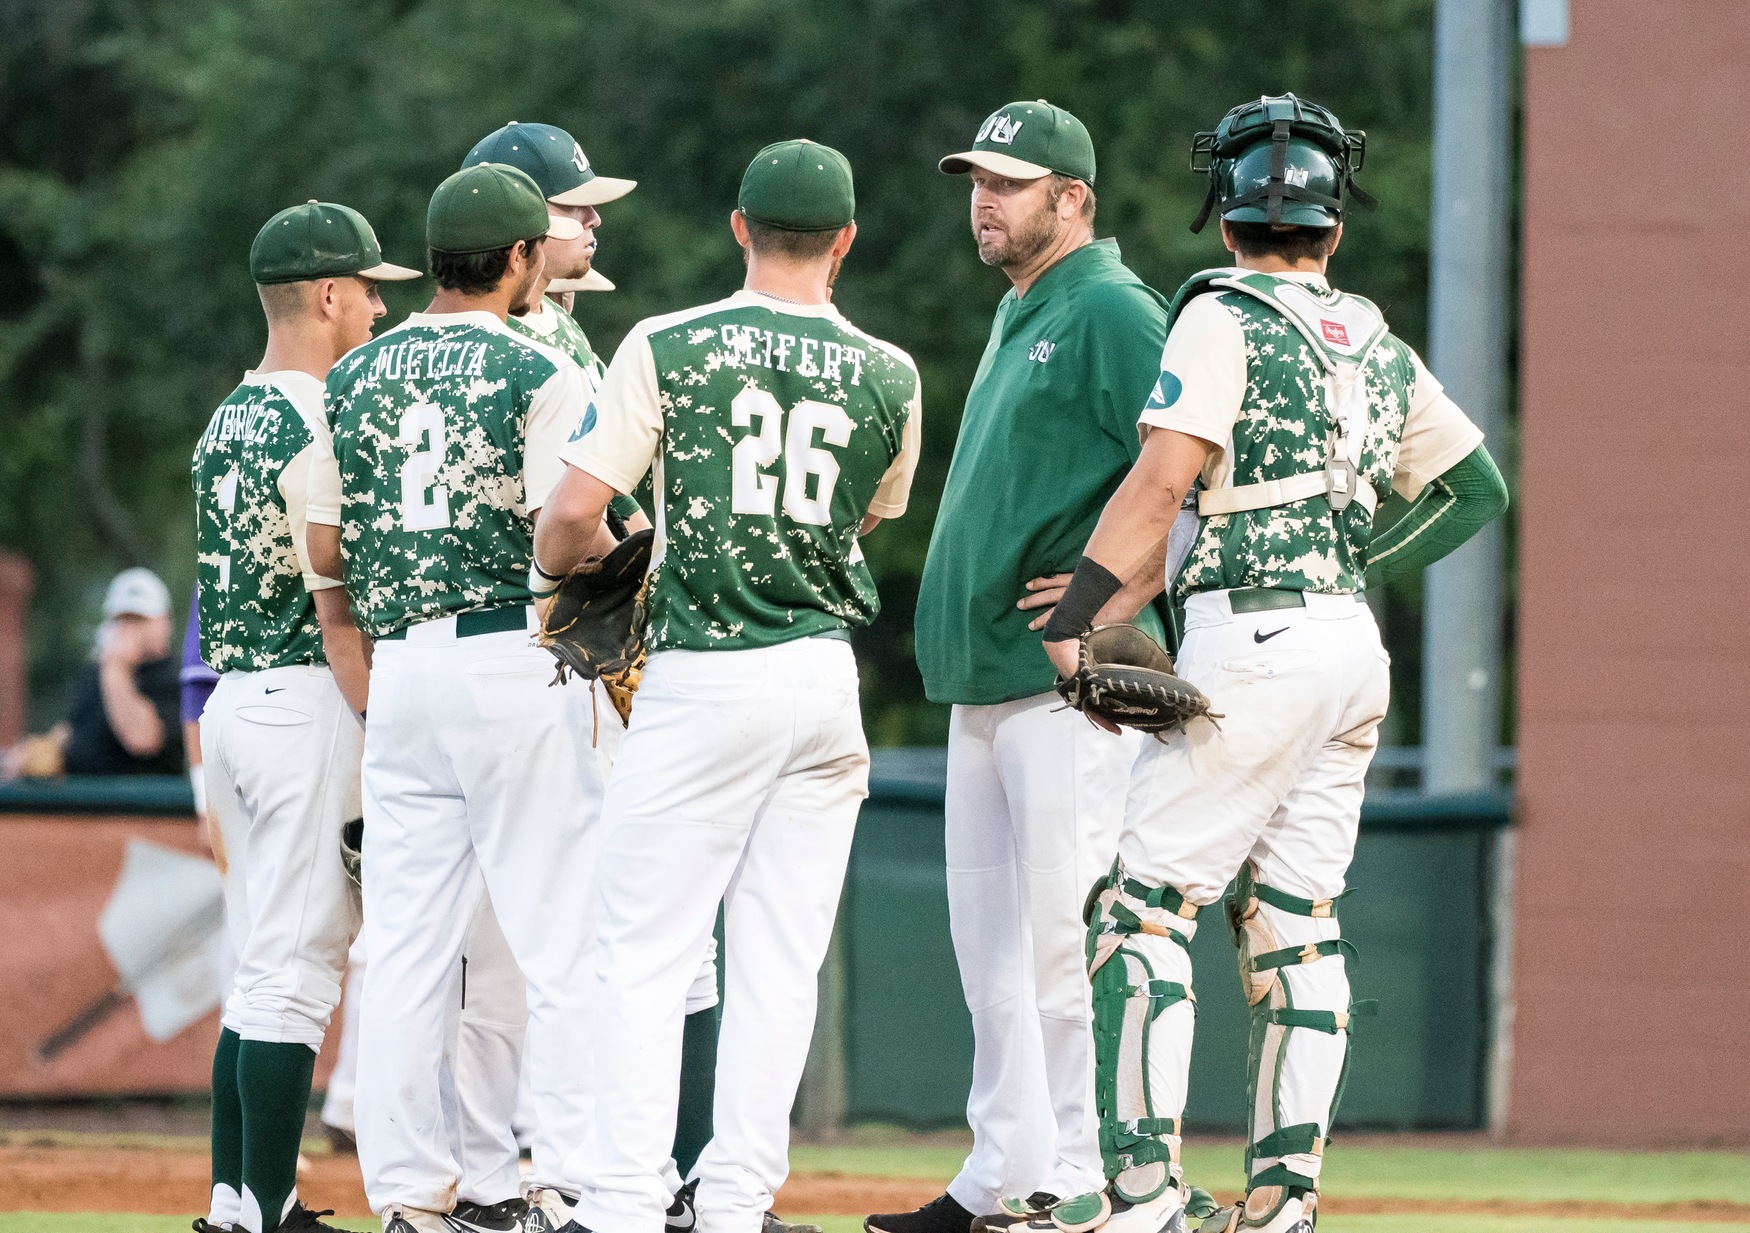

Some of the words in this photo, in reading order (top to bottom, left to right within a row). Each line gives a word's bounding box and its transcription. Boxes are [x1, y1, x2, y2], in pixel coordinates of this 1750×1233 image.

[720, 324, 866, 387] SEIFERT
[398, 402, 451, 532] 2
[731, 386, 853, 527] 26
